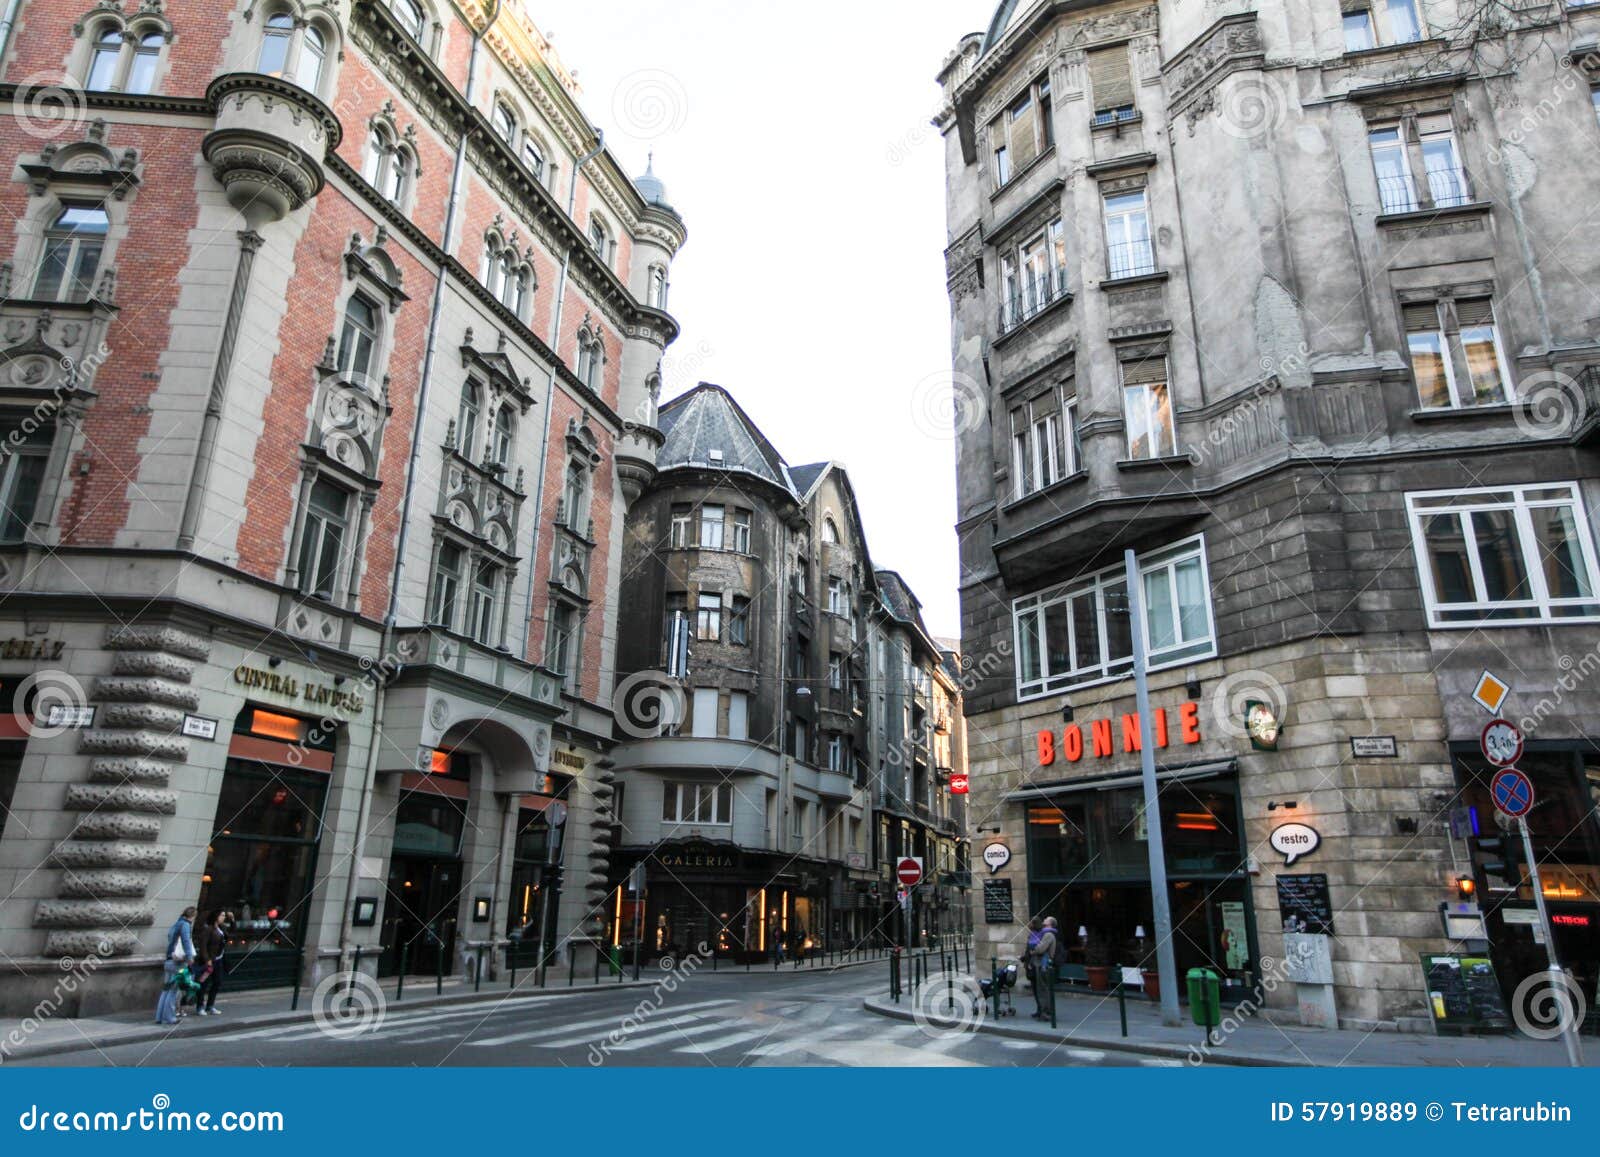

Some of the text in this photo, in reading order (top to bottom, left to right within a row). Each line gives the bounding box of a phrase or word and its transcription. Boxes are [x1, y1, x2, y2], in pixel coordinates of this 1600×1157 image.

[1037, 701, 1201, 766] BONNIE
[1280, 833, 1309, 844] restro
[986, 851, 1007, 859] comics
